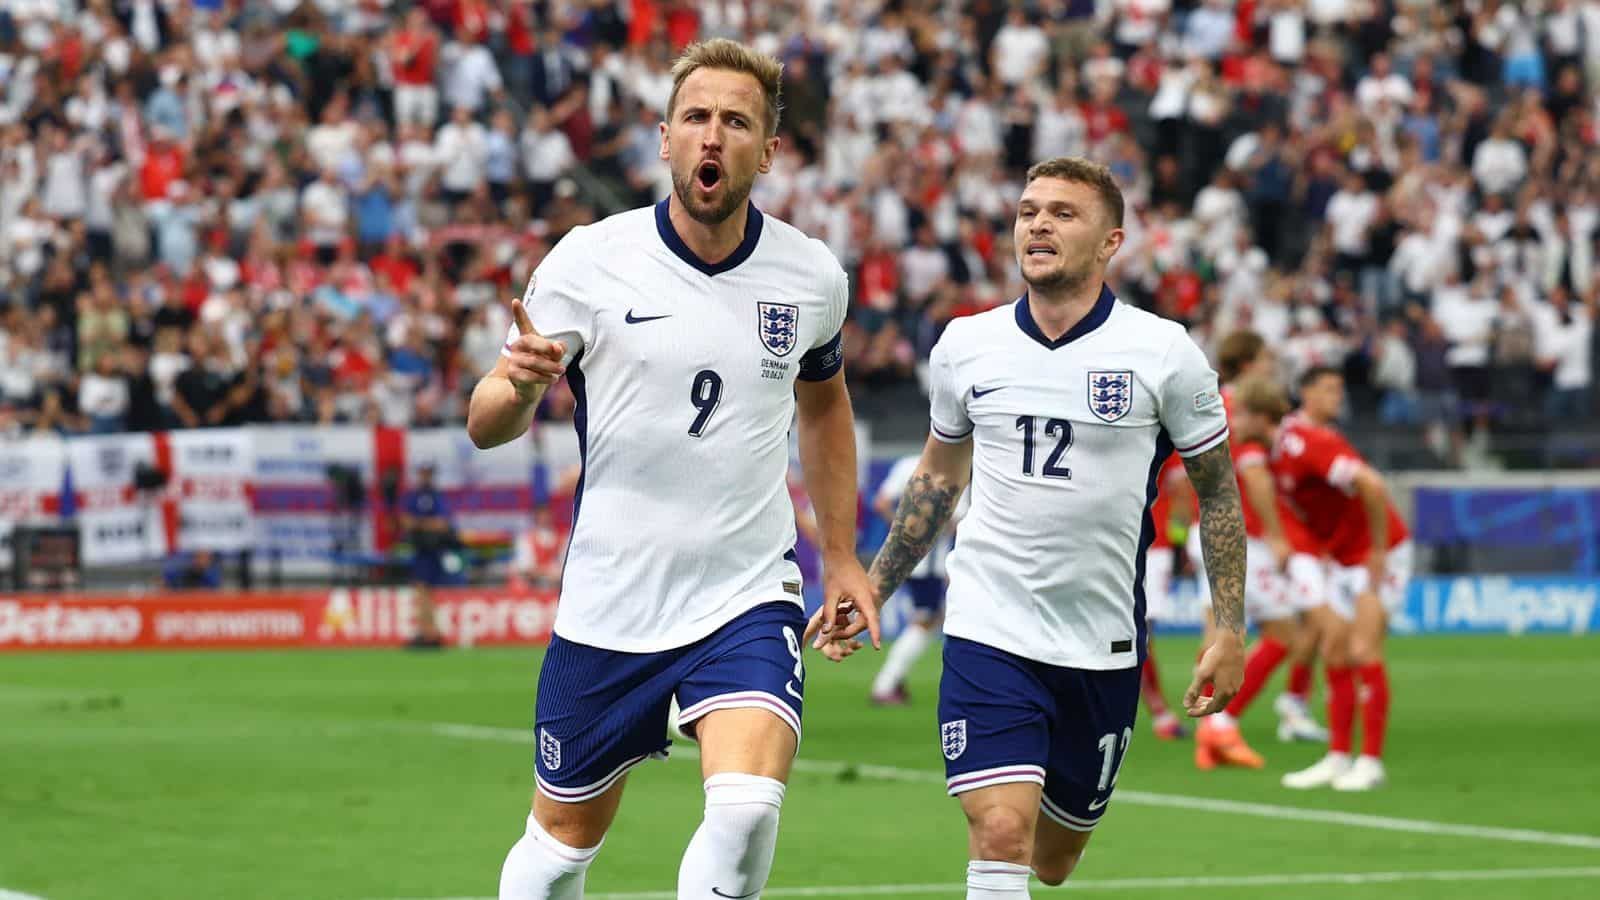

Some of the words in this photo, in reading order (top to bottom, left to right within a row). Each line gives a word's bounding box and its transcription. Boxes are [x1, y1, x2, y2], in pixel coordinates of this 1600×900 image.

[688, 369, 723, 438] 9
[1015, 415, 1074, 480] 12
[317, 586, 558, 649] AliExpre
[1443, 575, 1596, 636] Alipay
[782, 625, 803, 683] 9
[1097, 726, 1133, 791] 12
